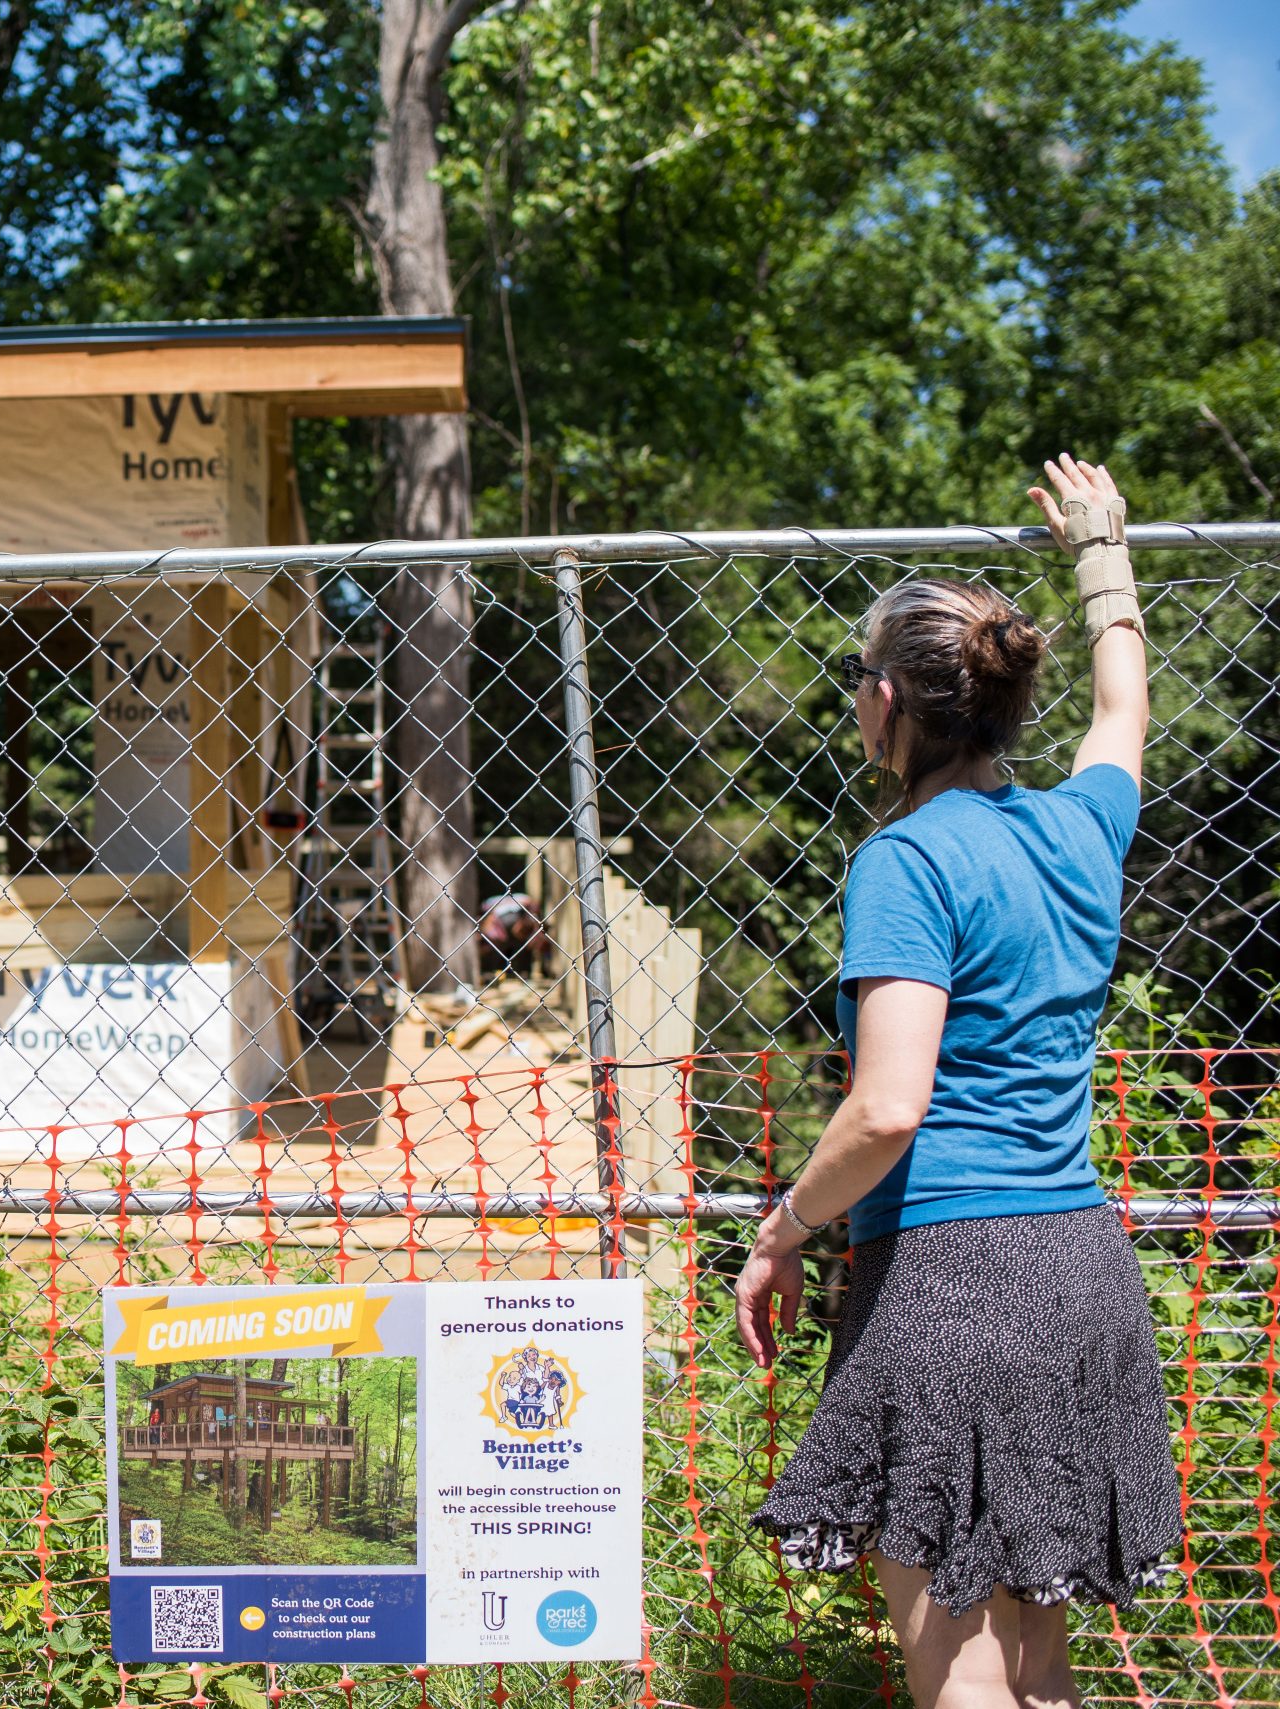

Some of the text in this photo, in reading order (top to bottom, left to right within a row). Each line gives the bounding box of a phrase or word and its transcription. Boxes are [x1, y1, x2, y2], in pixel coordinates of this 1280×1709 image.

[484, 1296, 575, 1309] Thanks to
[147, 1301, 355, 1351] COMING SOON
[440, 1317, 624, 1337] generous donations
[482, 1439, 583, 1454] Bennett's
[495, 1456, 570, 1472] Village
[438, 1484, 621, 1498] will begin construction on
[442, 1502, 617, 1514] the accessible treehouse
[471, 1522, 592, 1535] THIS SPRING!
[462, 1566, 600, 1581] in partnership with
[271, 1598, 375, 1610] Scan the QR Code
[278, 1614, 290, 1623] to
[292, 1613, 327, 1623] check
[329, 1614, 348, 1623] out
[563, 1618, 587, 1628] rec
[272, 1628, 376, 1641] construction plans
